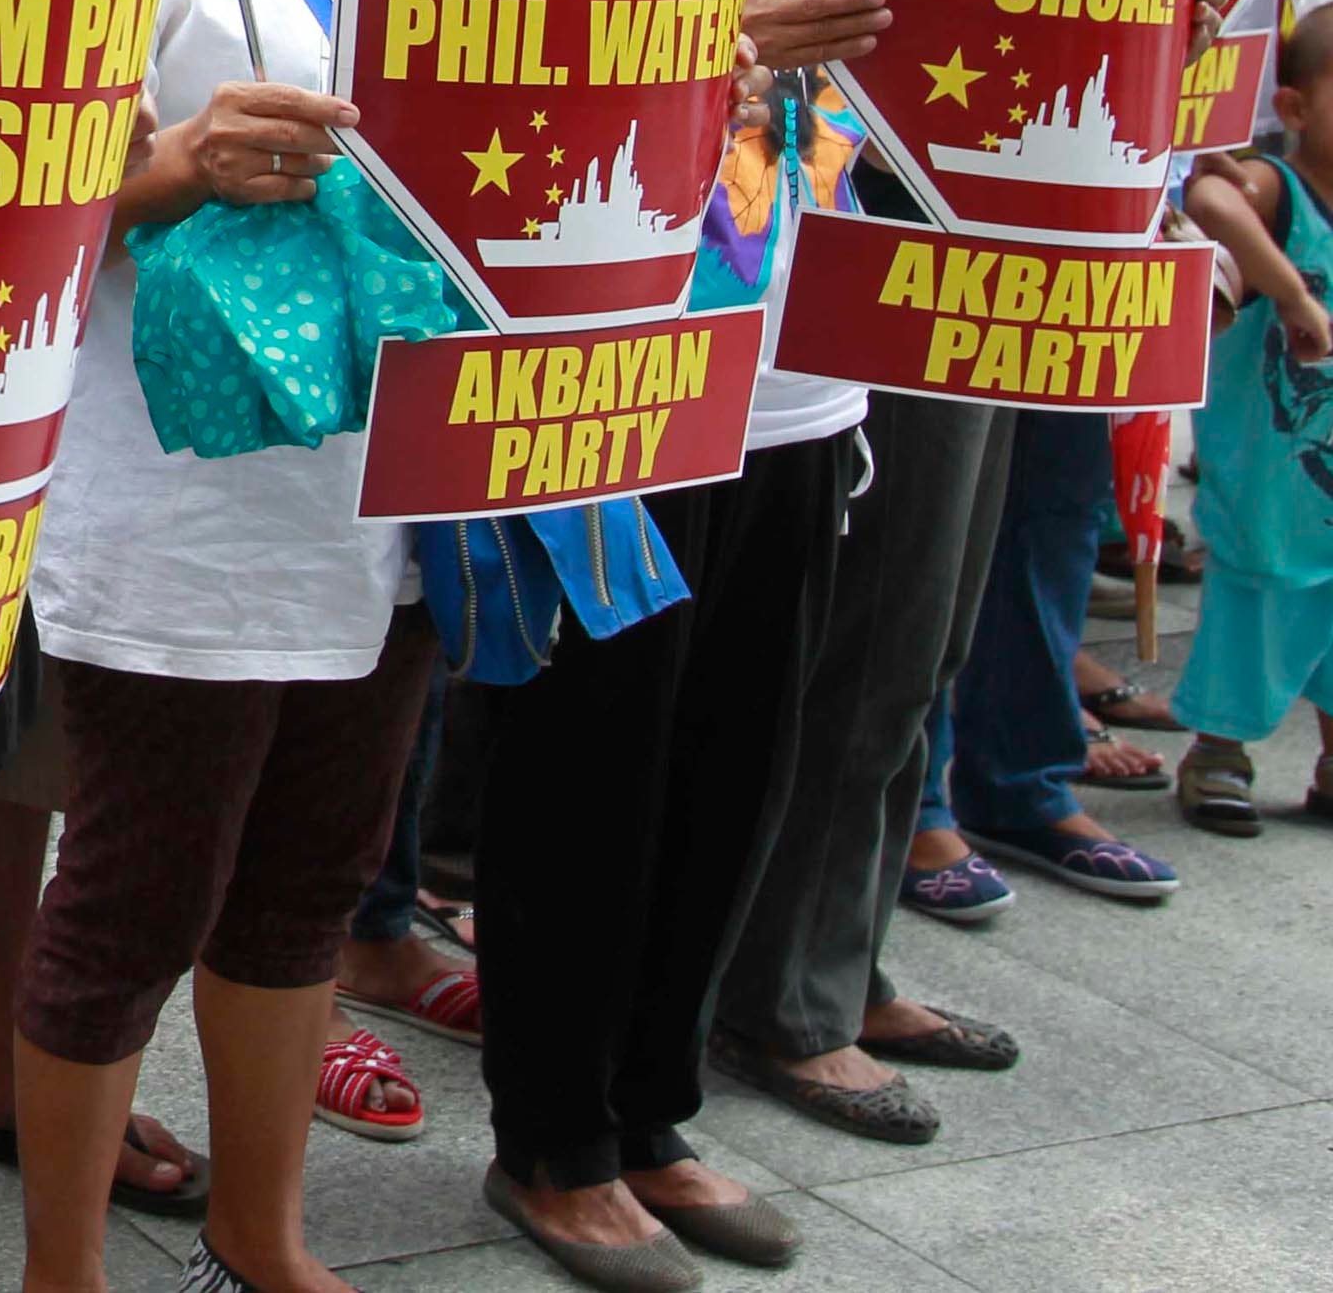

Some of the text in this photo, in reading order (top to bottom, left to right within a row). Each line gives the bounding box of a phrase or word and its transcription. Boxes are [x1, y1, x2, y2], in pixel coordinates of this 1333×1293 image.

[878, 239, 1176, 328] AKBAYAN
[447, 329, 712, 425] AKBAYAN
[922, 315, 1144, 399] PARTY
[487, 408, 671, 501] PARTY
